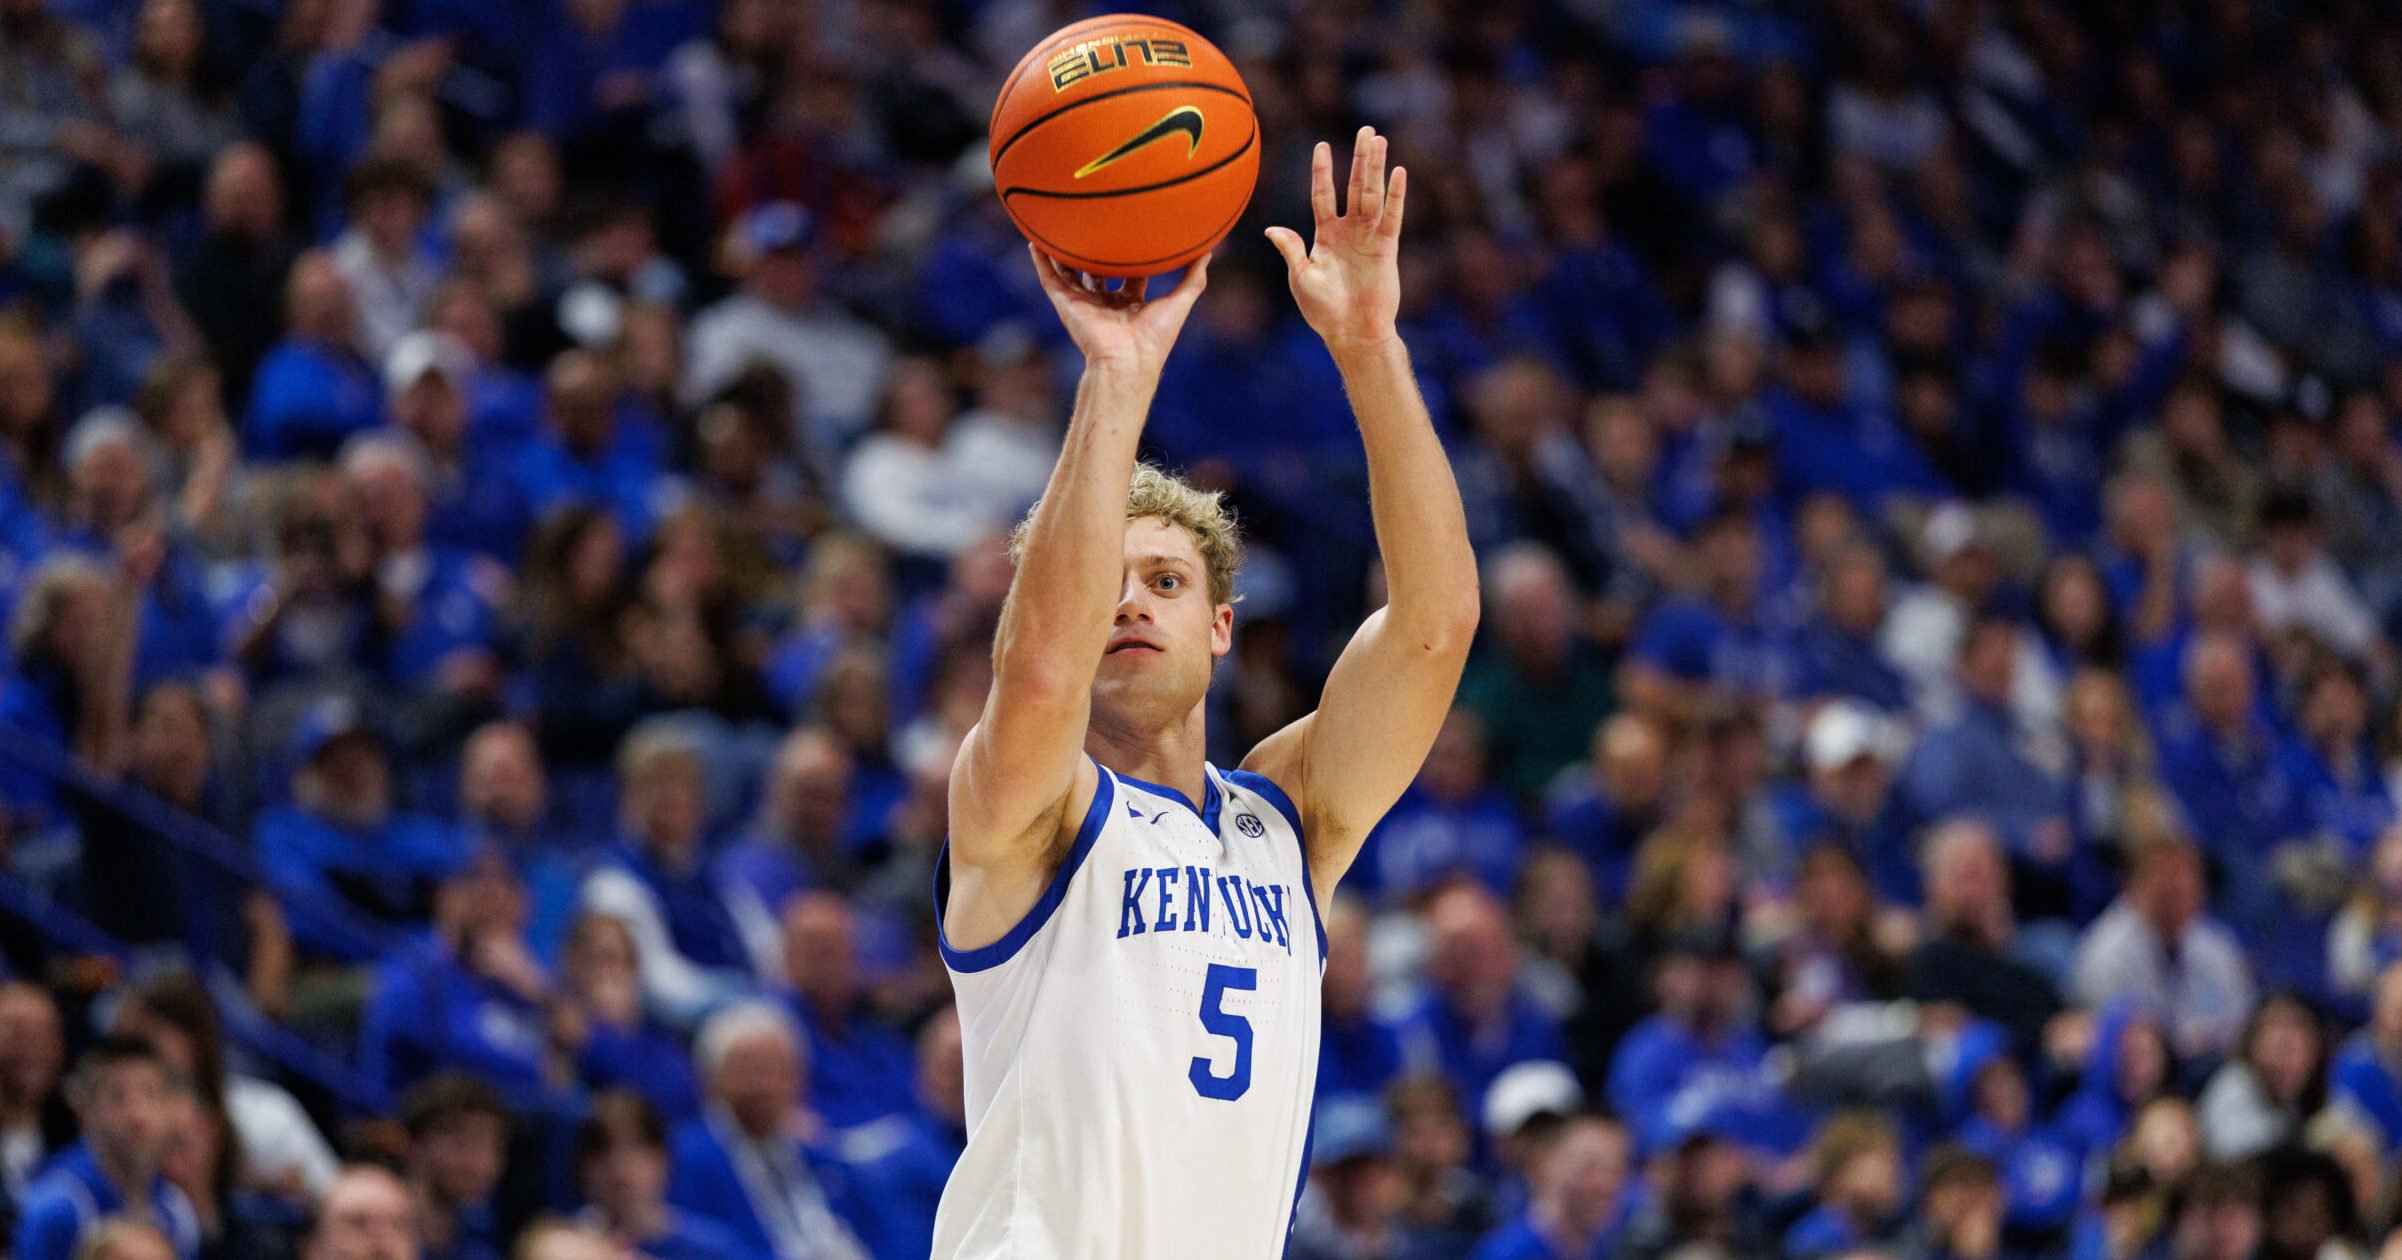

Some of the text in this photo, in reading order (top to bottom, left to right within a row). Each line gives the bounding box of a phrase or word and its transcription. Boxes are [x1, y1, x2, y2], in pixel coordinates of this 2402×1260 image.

[1048, 39, 1193, 94] ELITE
[1236, 813, 1265, 838] SEC
[1117, 865, 1291, 957] KENUCK
[1188, 962, 1257, 1102] 5
